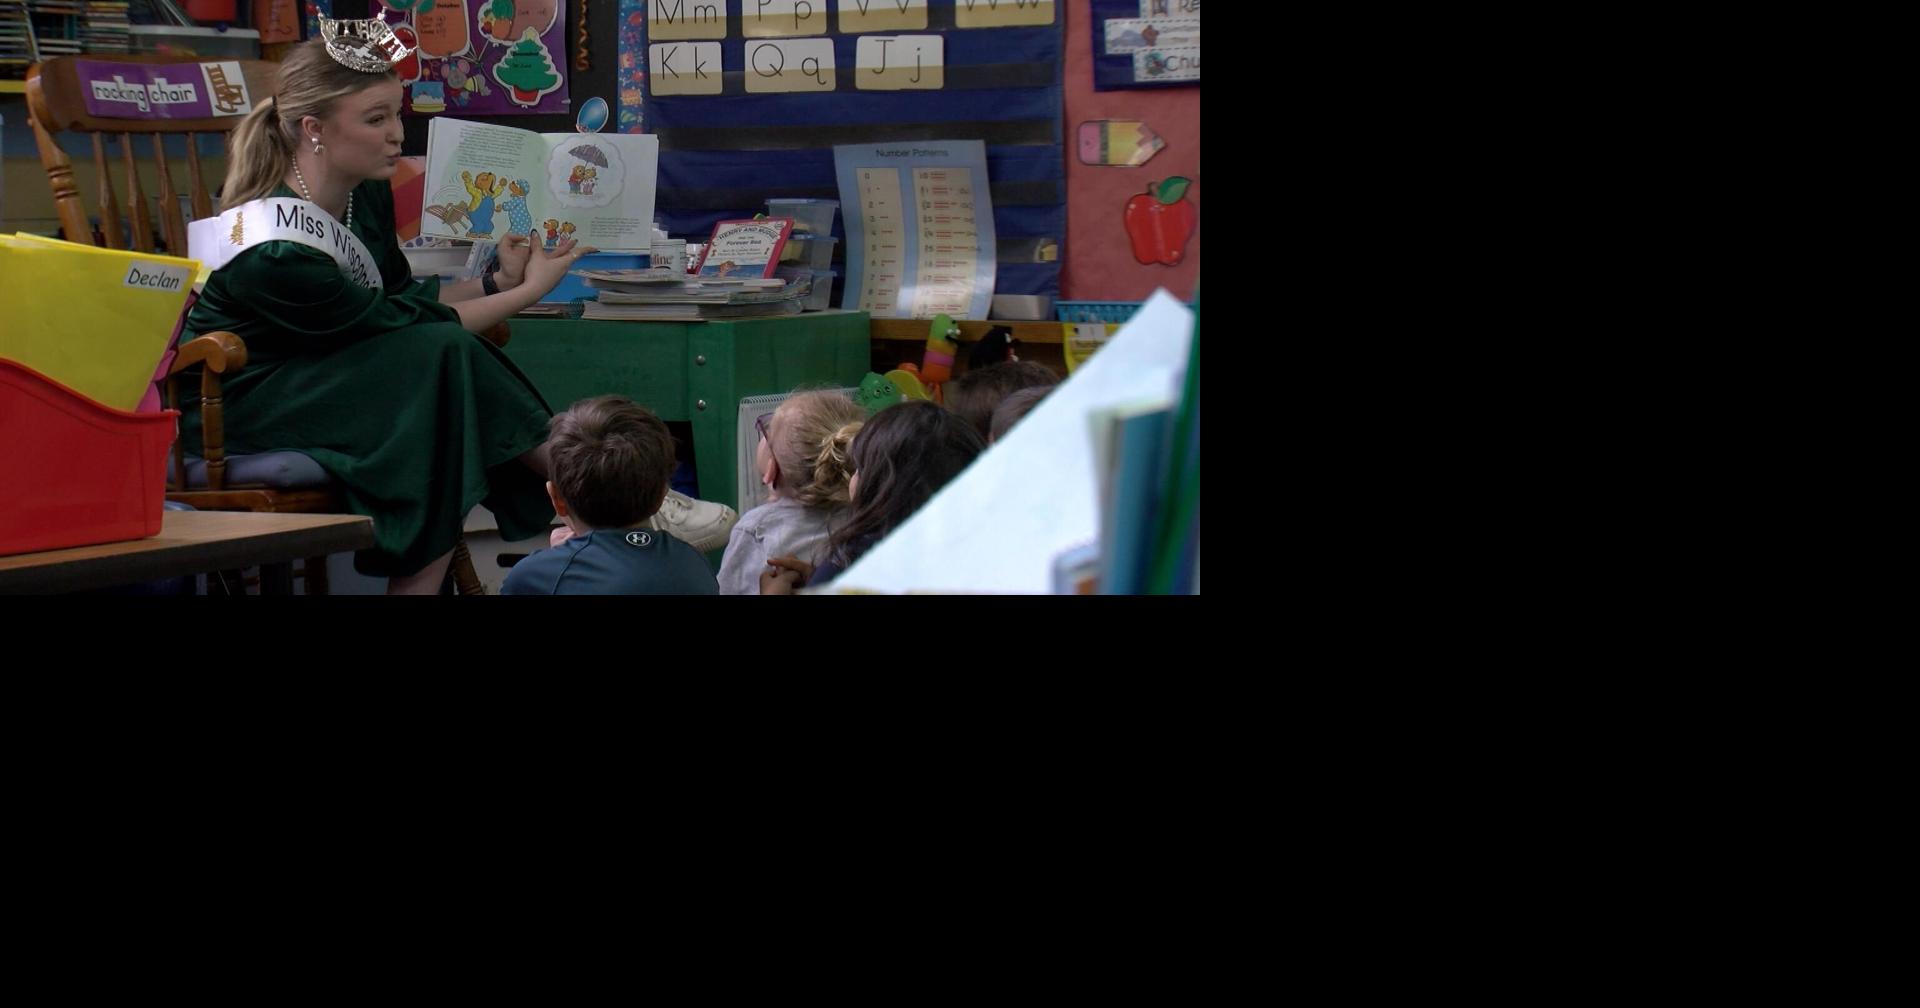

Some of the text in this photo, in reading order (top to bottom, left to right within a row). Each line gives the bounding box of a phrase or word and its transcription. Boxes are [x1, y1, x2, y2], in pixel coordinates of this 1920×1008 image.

[94, 78, 193, 111] rocking chair
[875, 148, 910, 158] Number
[276, 203, 325, 239] Miss
[330, 221, 378, 288] Wiscon
[127, 267, 180, 290] Declan
